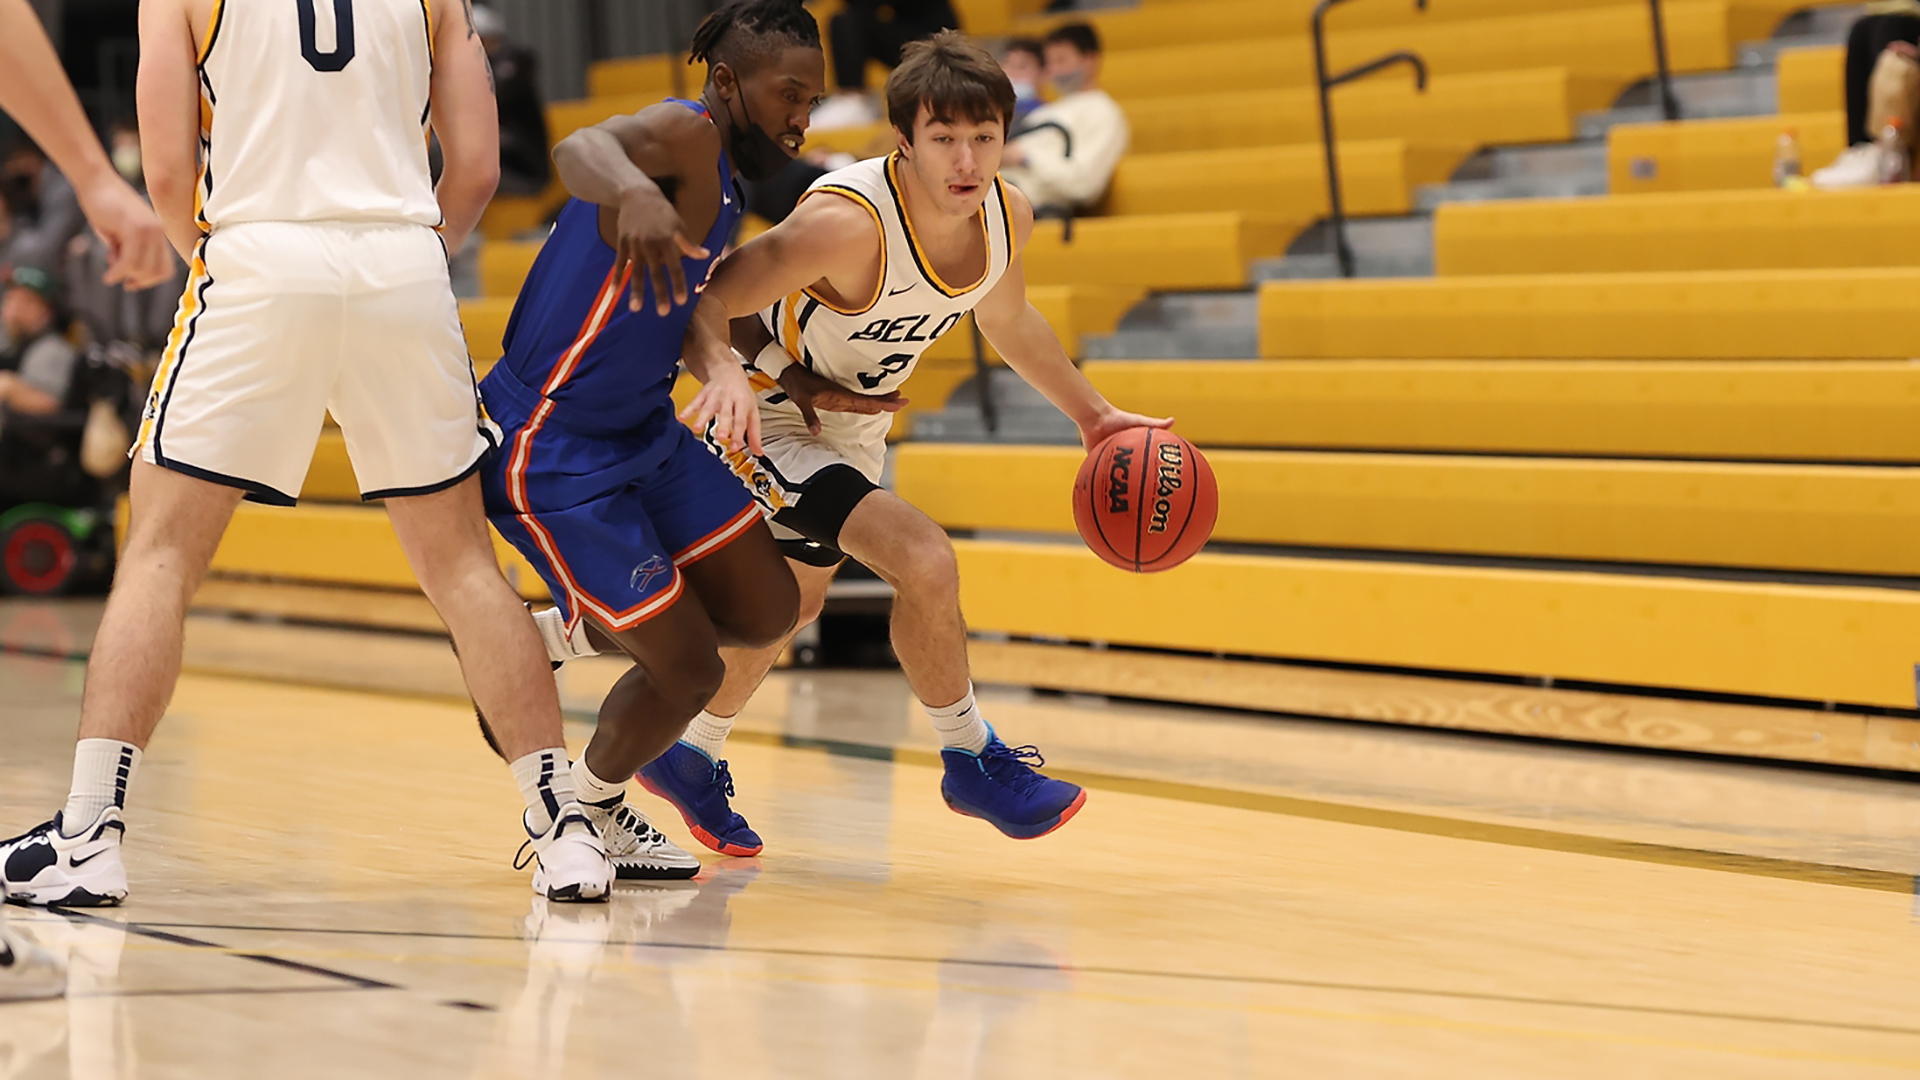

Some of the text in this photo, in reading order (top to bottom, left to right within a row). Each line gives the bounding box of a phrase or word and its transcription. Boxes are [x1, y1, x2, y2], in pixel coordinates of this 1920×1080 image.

[296, 0, 355, 72] 0
[847, 310, 968, 342] BELO
[857, 353, 914, 389] 3
[1109, 446, 1134, 514] NCAA
[1148, 441, 1183, 534] Wilson
